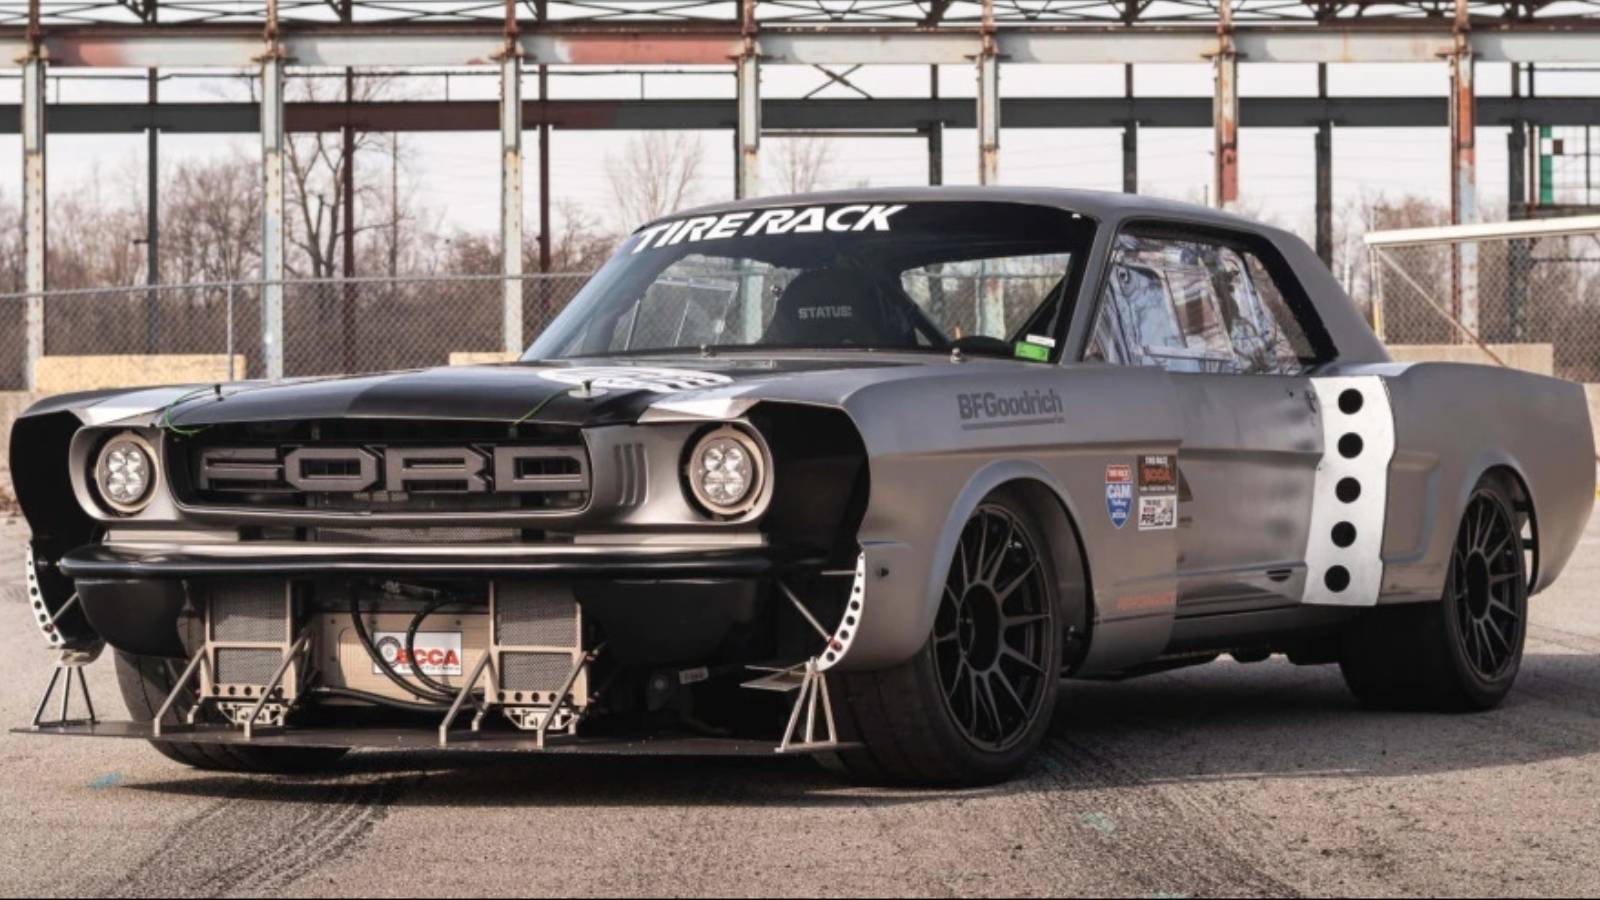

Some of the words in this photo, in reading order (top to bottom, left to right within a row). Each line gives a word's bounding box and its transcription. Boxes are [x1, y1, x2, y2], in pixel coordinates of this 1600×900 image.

[631, 211, 754, 254] TIRE
[743, 204, 908, 236] RACK
[957, 388, 1065, 419] BFGoodrich
[199, 445, 592, 492] FORD
[1108, 484, 1131, 499] CAM
